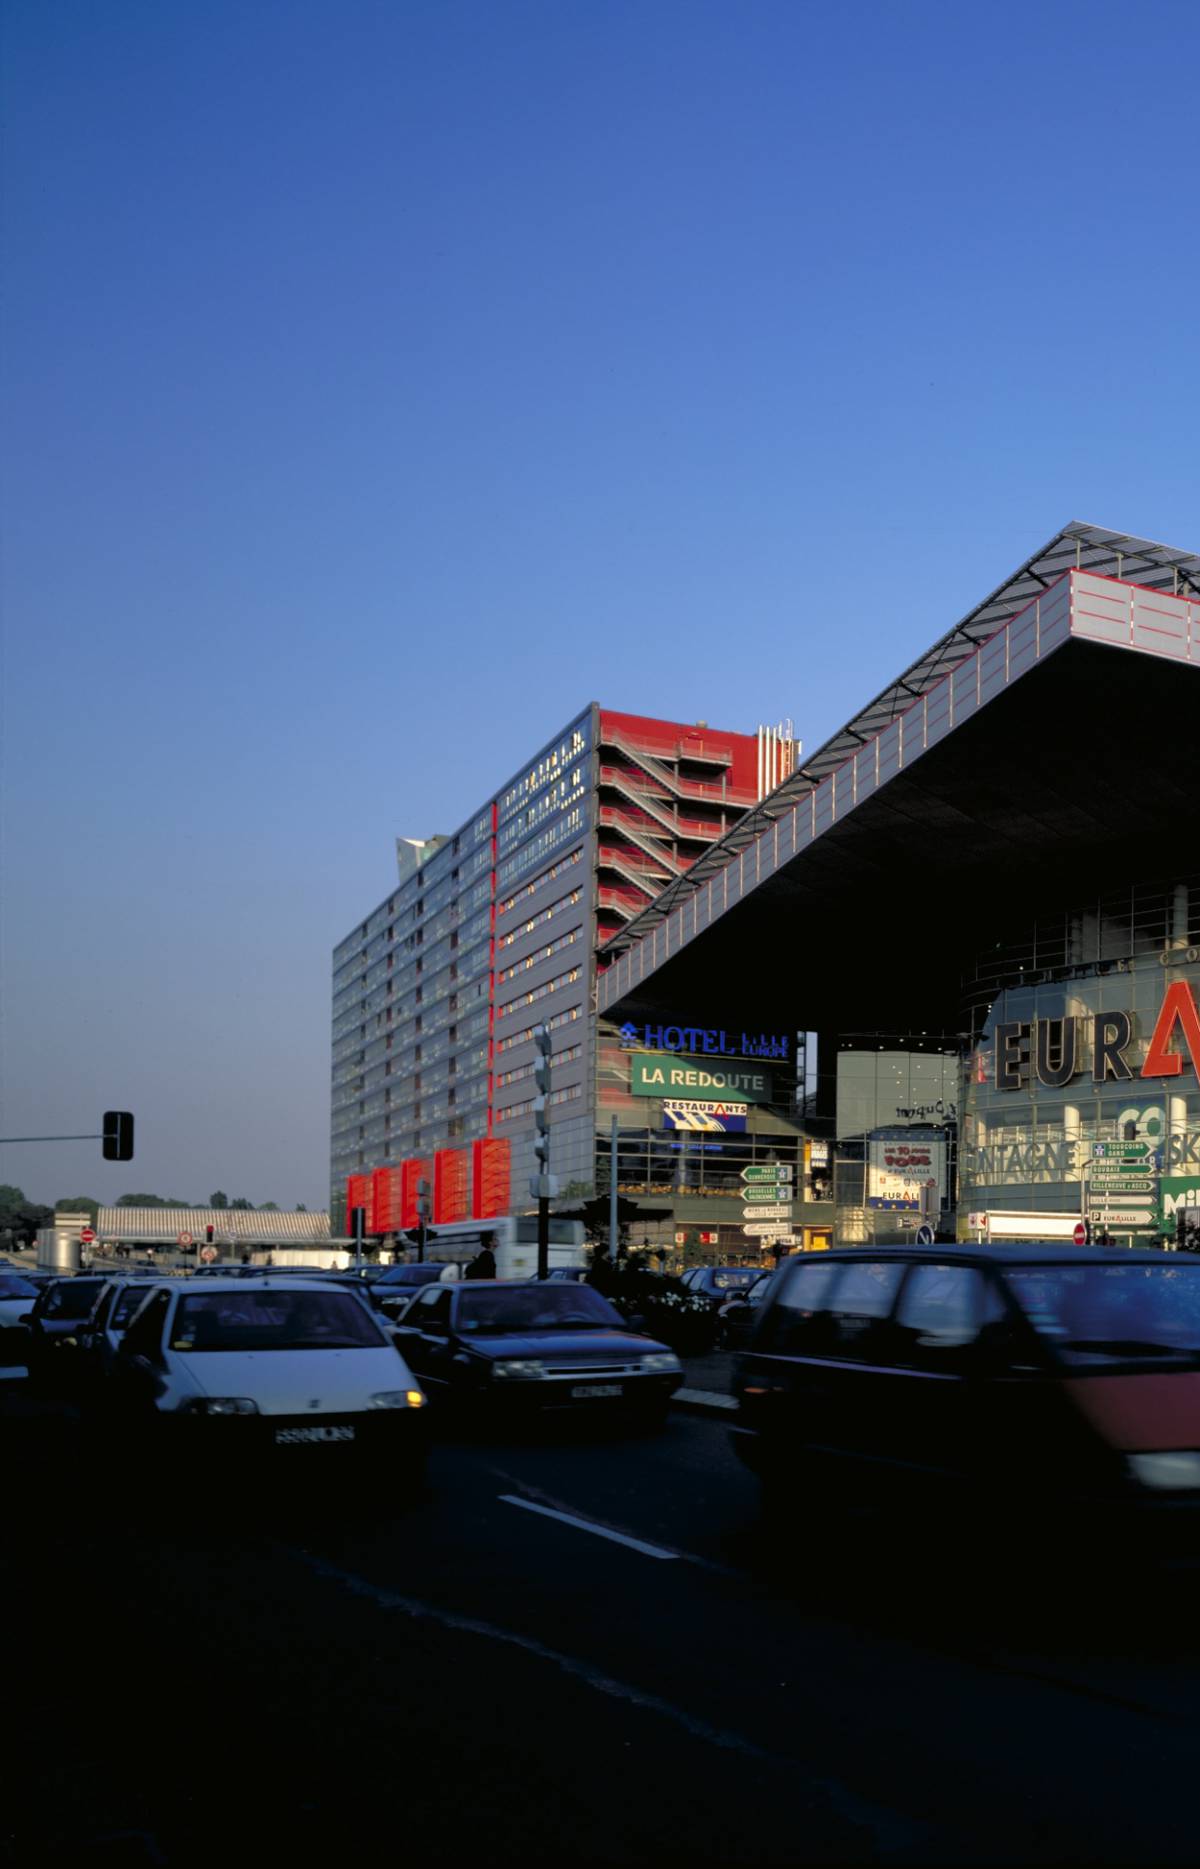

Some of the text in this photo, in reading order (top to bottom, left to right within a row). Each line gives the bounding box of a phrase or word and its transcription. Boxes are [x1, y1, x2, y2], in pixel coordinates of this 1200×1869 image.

[644, 1024, 735, 1055] HOTEL
[642, 1067, 764, 1090] LA REDOUTE
[664, 1101, 747, 1118] RESTAURANTS
